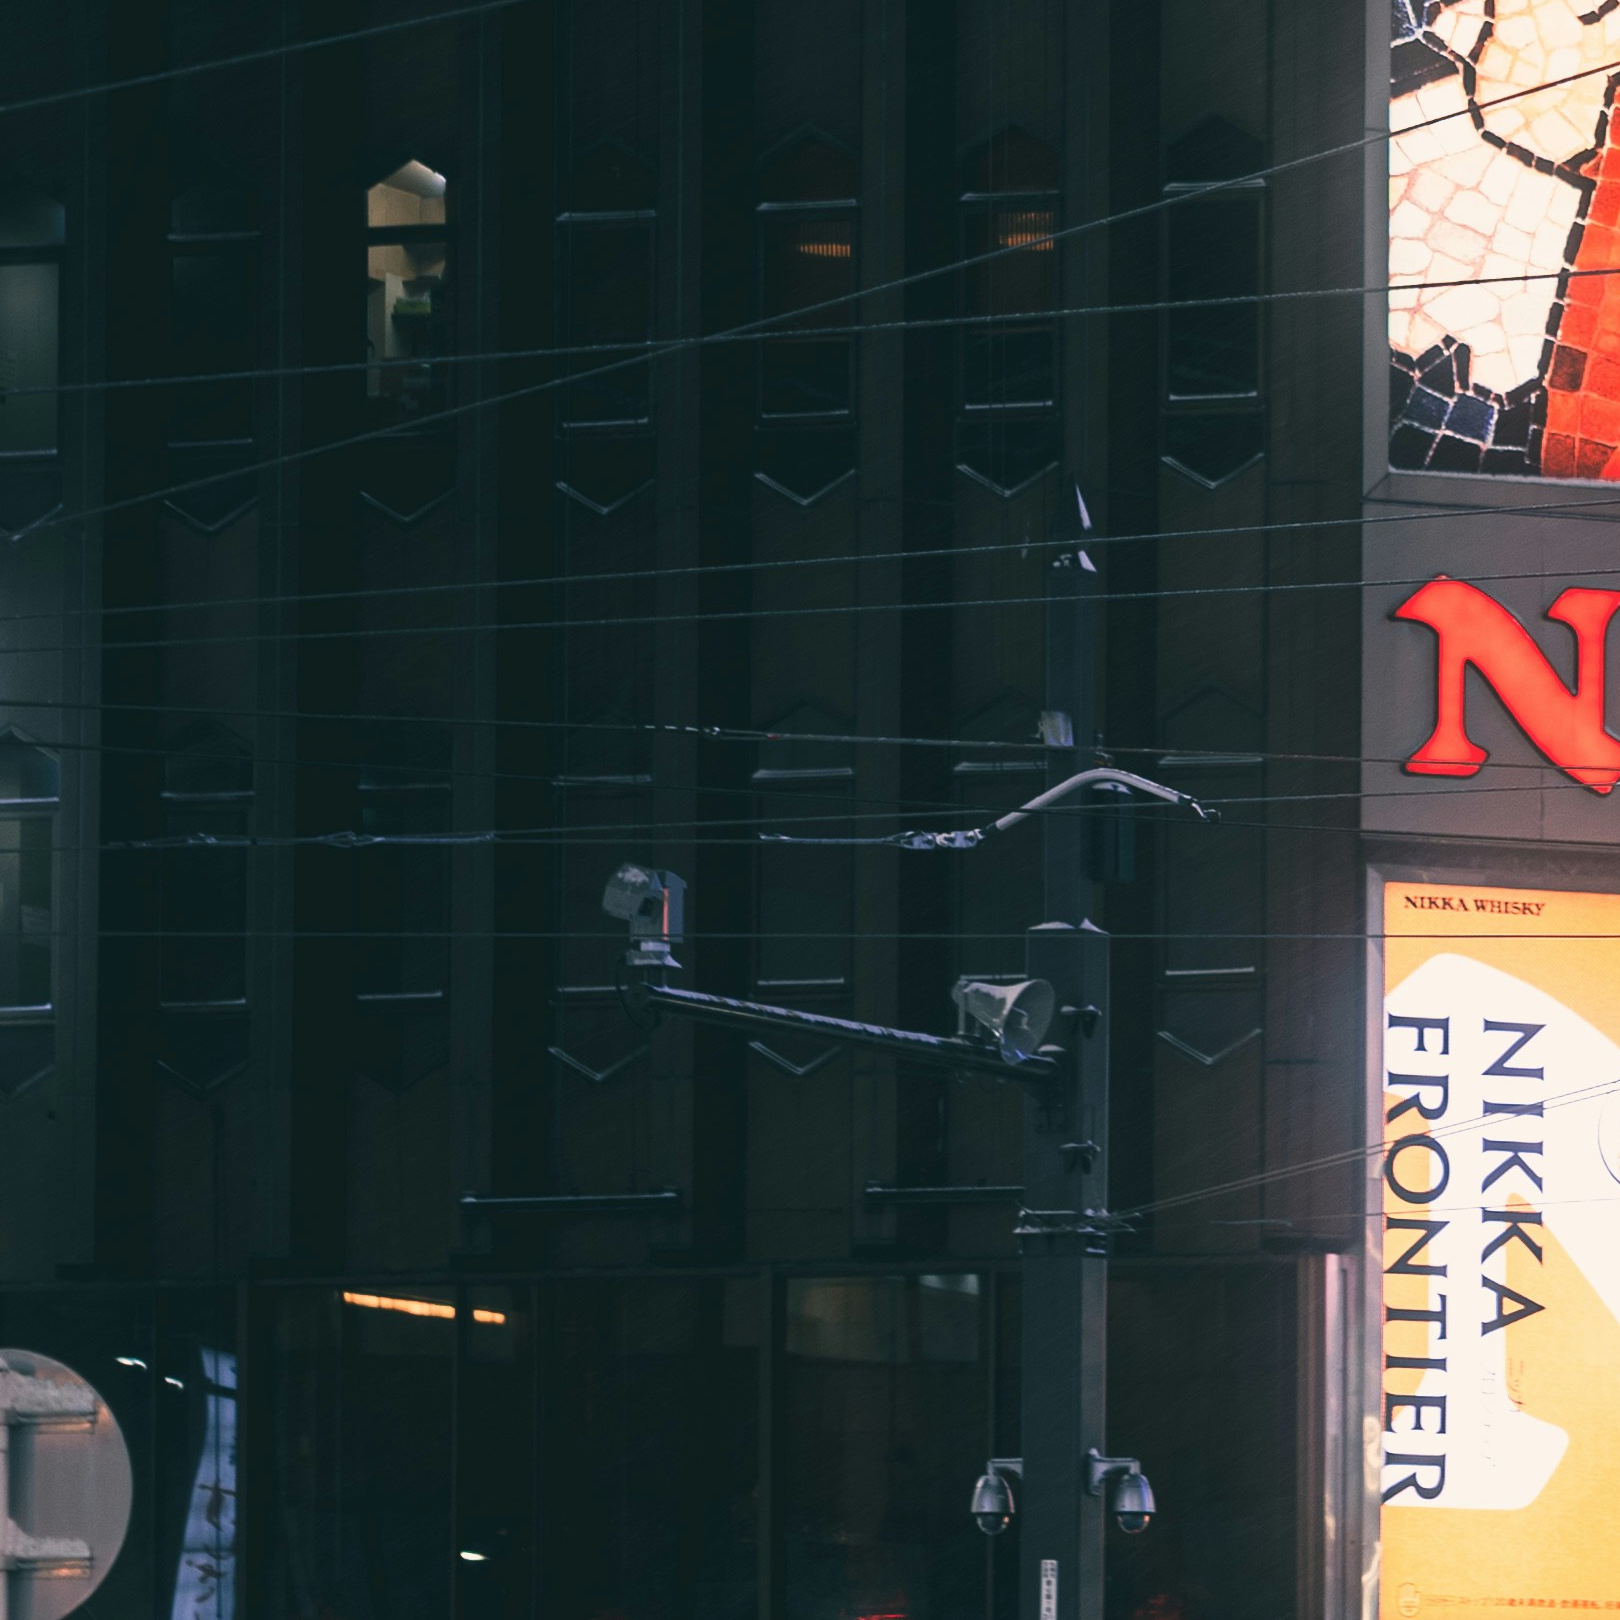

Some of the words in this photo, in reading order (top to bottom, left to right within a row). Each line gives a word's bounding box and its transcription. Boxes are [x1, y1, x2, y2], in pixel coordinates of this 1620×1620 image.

[1404, 895, 1470, 912] NIKKA
[1473, 899, 1546, 916] WHISKY
[1381, 1013, 1451, 1505] FRONTIER
[1480, 1016, 1547, 1338] NIKKA
